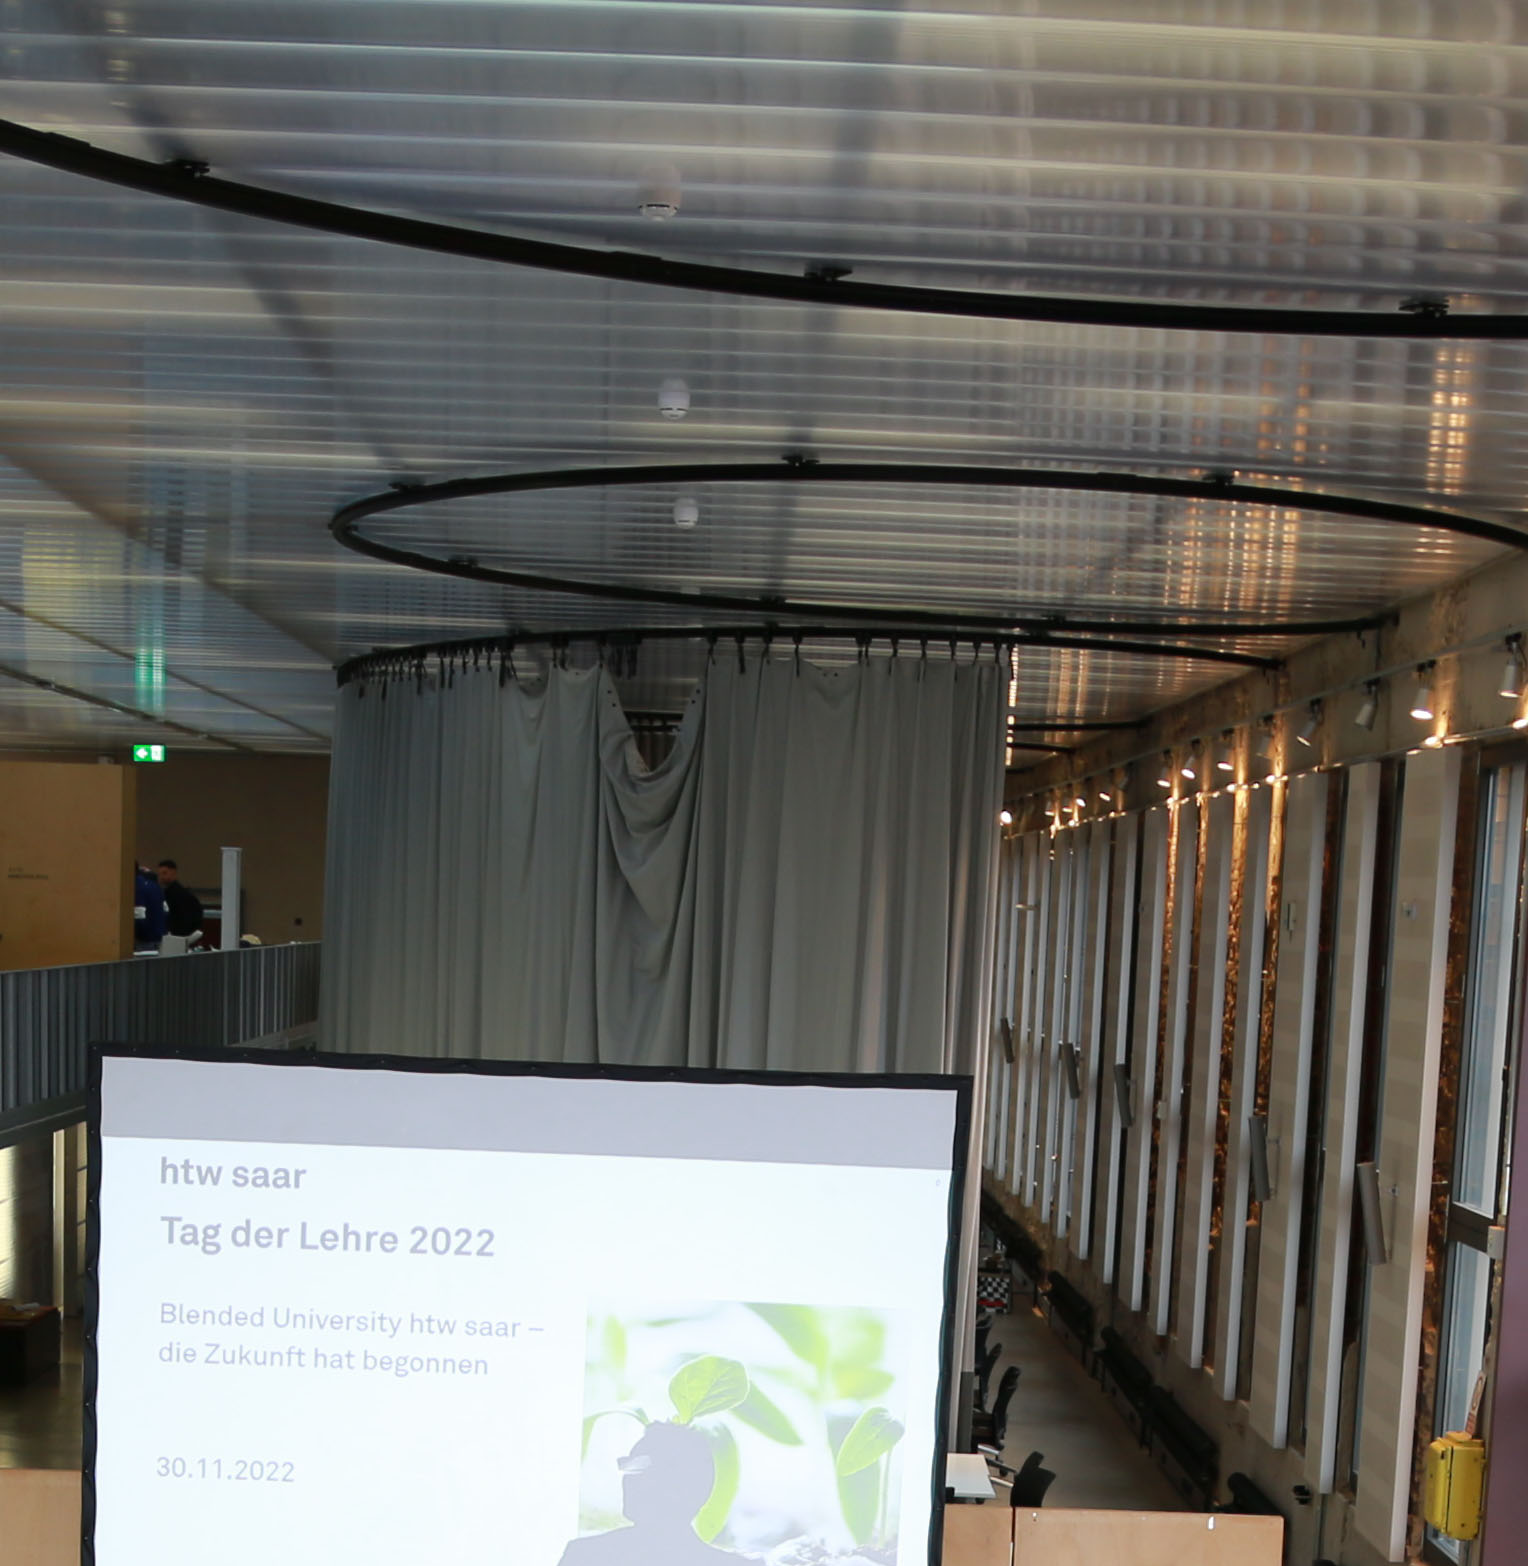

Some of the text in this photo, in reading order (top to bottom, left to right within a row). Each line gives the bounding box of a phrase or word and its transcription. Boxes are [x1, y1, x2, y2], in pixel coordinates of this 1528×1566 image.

[160, 1156, 307, 1189] htw saar
[160, 1215, 495, 1257] Tag der Lehre 2022
[160, 1302, 265, 1328] Blended
[273, 1307, 403, 1339] University
[409, 1312, 457, 1336] htw
[464, 1318, 521, 1338] saar
[158, 1341, 489, 1378] die Zukunft hat begonnen
[155, 1456, 295, 1483] 30.11.2022
